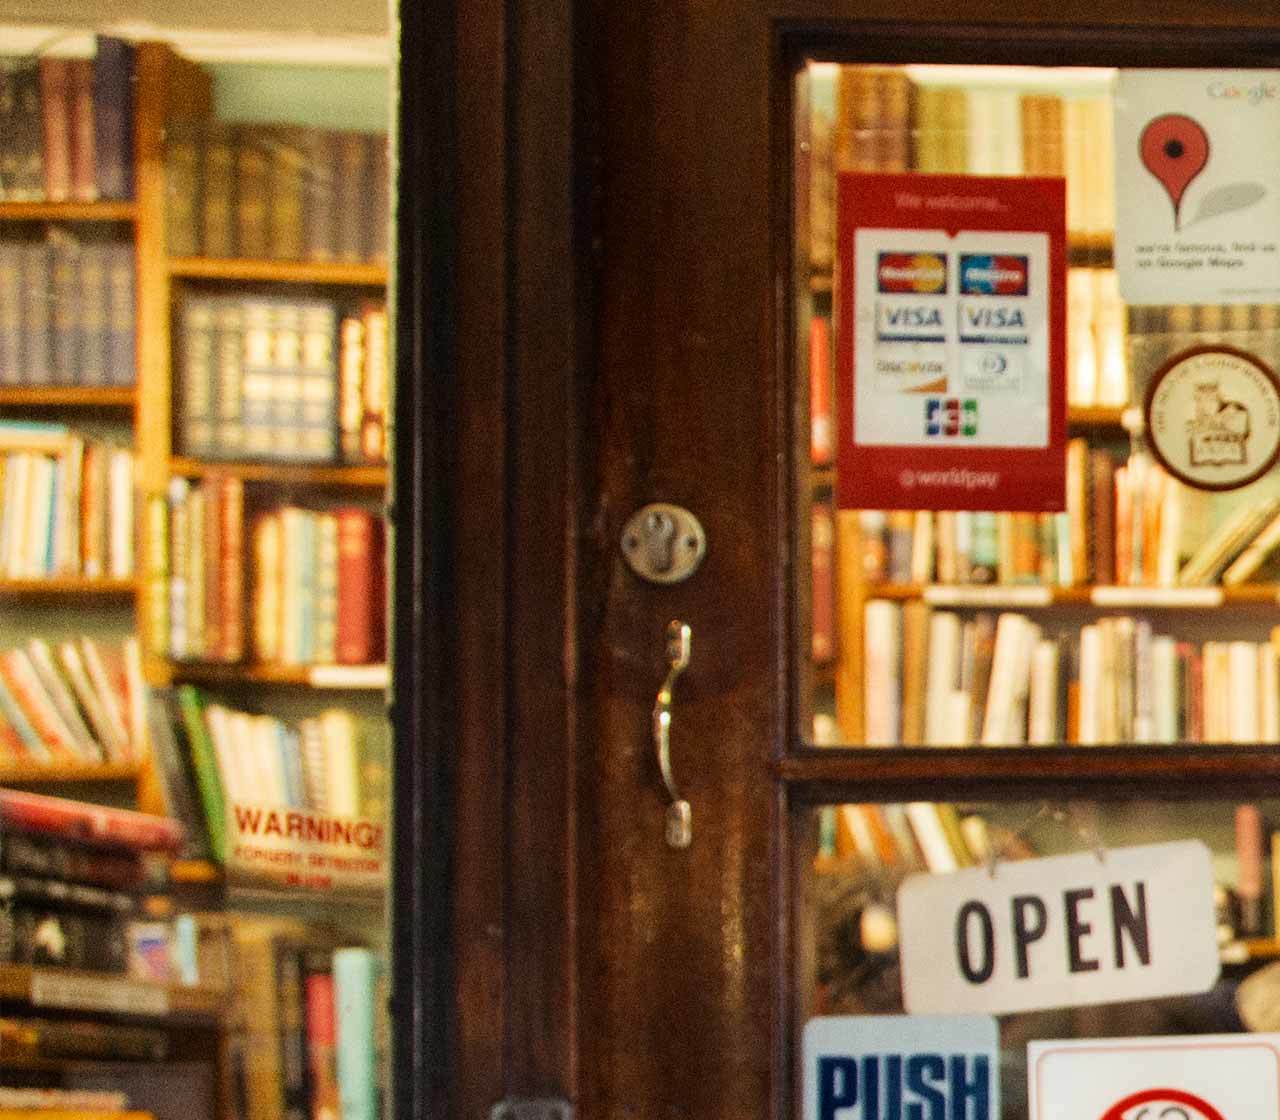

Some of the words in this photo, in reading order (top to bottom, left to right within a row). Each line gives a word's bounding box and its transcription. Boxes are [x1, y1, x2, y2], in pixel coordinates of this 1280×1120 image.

[1207, 80, 1278, 106] Google
[885, 305, 943, 327] VISA
[966, 306, 1026, 328] VISA
[234, 804, 384, 850] WARNING!
[955, 880, 1152, 985] OPEN
